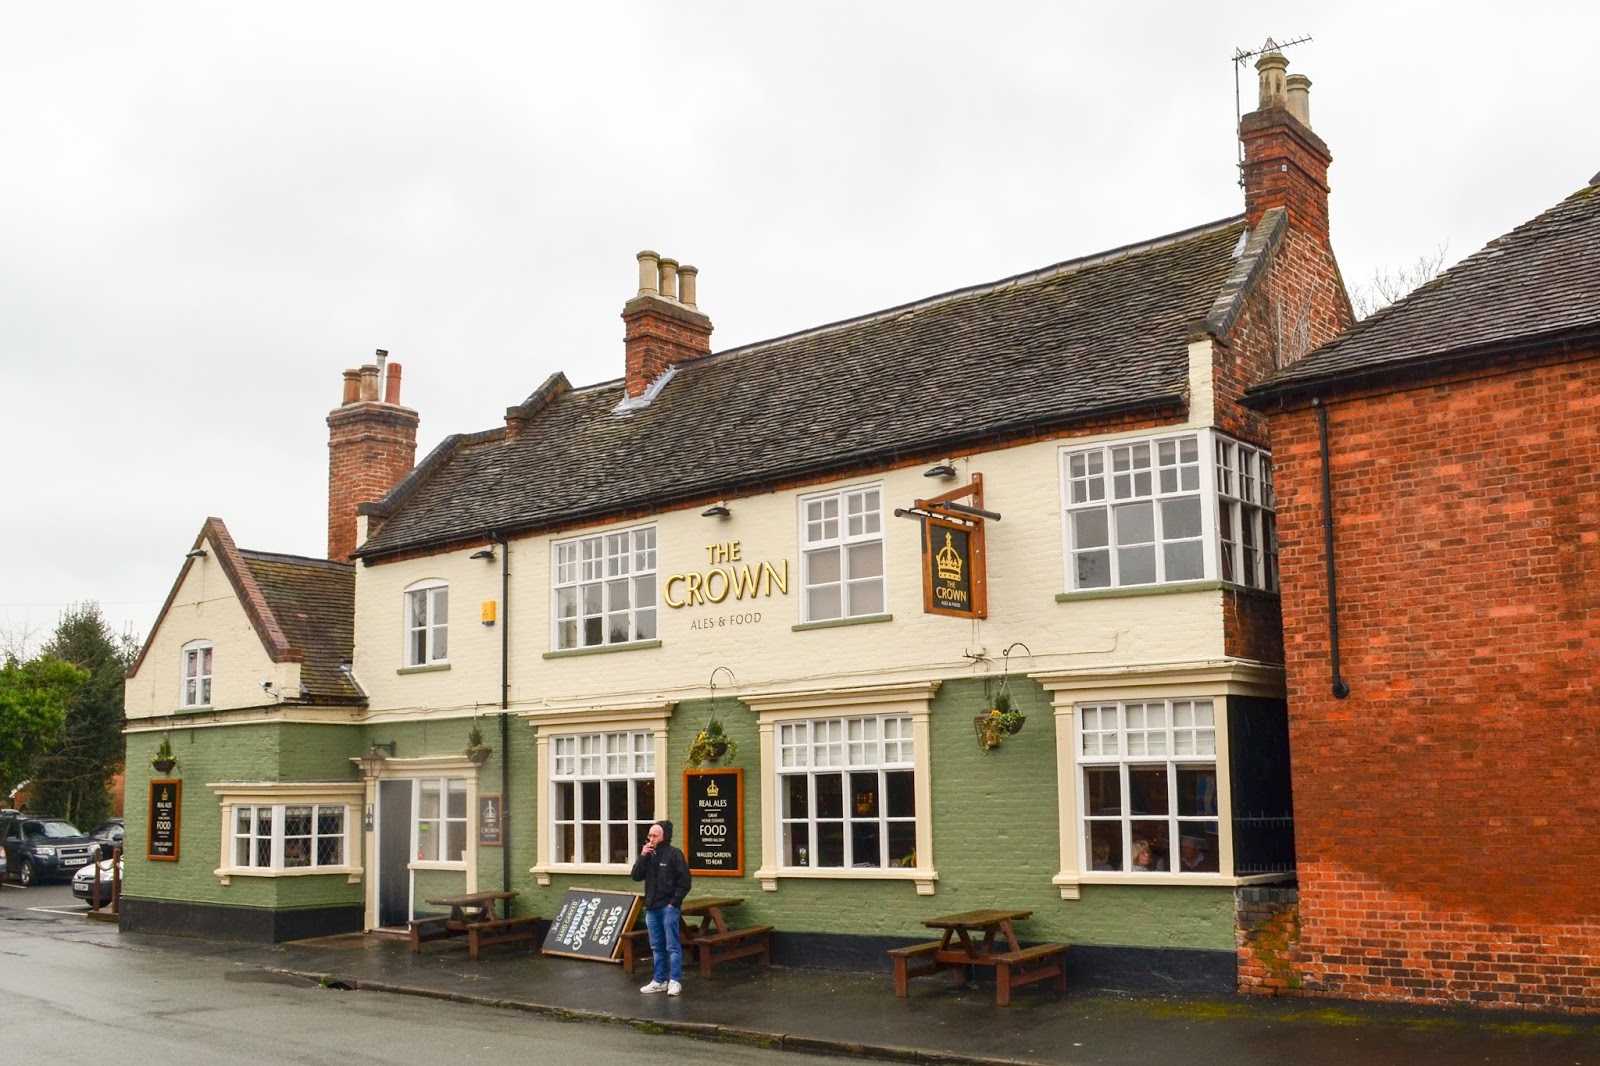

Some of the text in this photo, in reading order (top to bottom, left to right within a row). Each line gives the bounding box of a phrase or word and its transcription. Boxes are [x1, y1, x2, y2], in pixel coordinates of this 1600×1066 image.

[706, 540, 741, 564] THE
[664, 559, 788, 609] CROWN
[936, 587, 967, 602] CROWN
[690, 612, 762, 630] ALES & FOOD
[156, 821, 171, 830] FOOD
[700, 825, 727, 836] FOOD
[557, 901, 578, 941] HAND CARVED
[563, 898, 588, 945] SUNDAY
[571, 897, 601, 950] Roasts
[598, 906, 623, 945] £9.95
